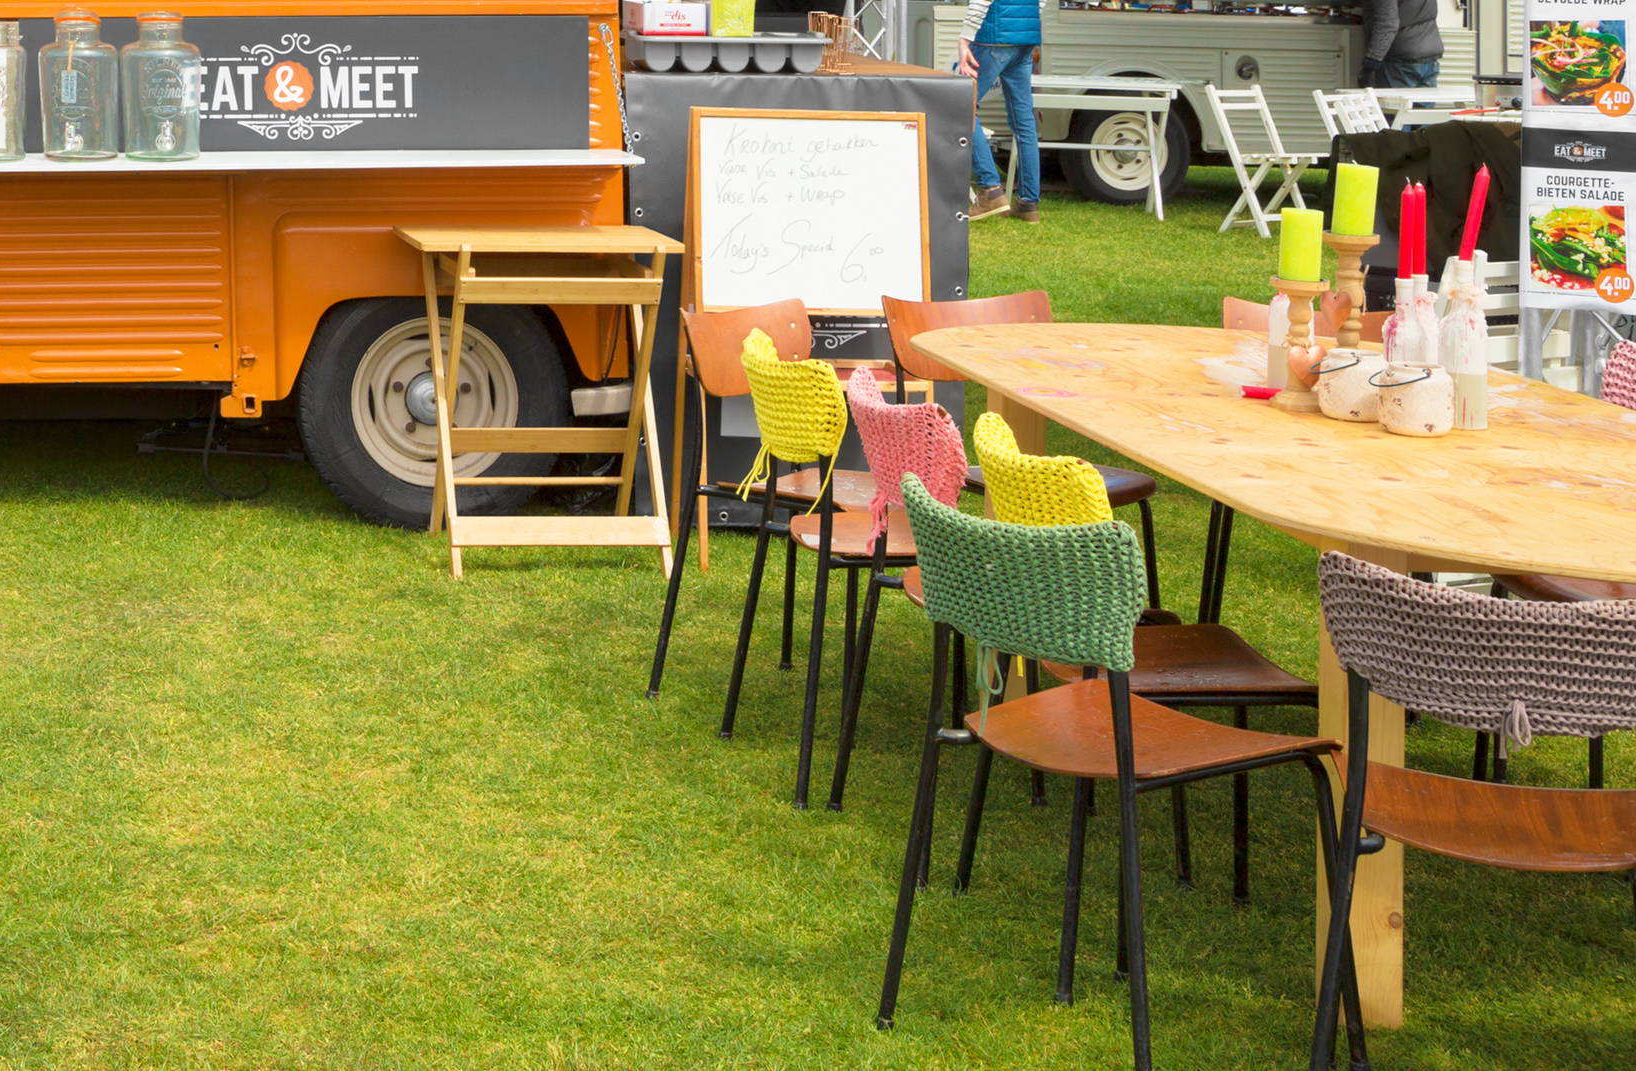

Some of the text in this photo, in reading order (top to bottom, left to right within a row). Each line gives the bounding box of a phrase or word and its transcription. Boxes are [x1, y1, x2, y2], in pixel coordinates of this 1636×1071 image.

[182, 66, 419, 111] EAT & MEET
[1599, 90, 1631, 110] 4.00
[1554, 146, 1571, 156] EAT
[1583, 147, 1606, 157] MEET
[1546, 175, 1615, 188] COURGETTE-
[750, 181, 768, 204] Vis
[1536, 187, 1625, 201] BIETEN SALADE
[1599, 276, 1631, 296] 4.00
